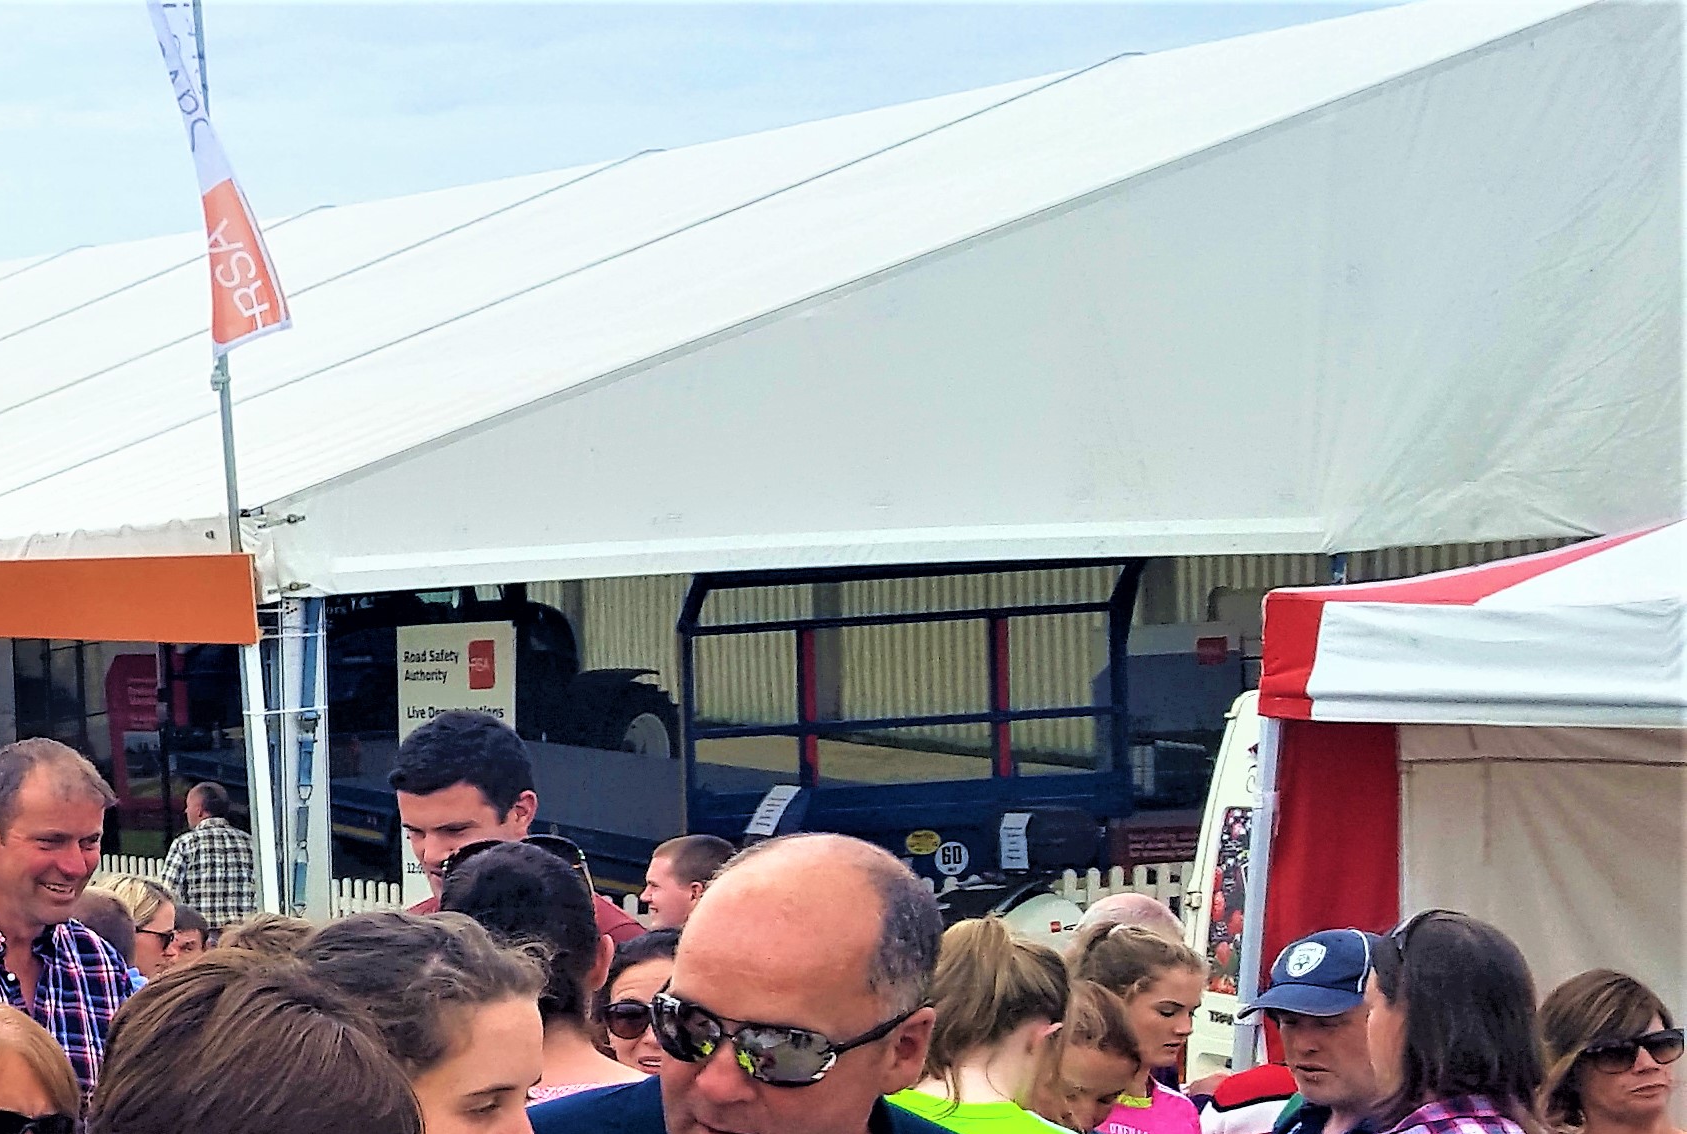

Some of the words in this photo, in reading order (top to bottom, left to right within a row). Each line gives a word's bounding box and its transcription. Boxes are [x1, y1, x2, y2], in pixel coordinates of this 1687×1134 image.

[207, 217, 270, 329] RSA
[403, 650, 427, 663] Road
[429, 649, 460, 665] Safety
[404, 669, 448, 684] Authority
[407, 705, 426, 719] Live
[941, 845, 962, 866] 60
